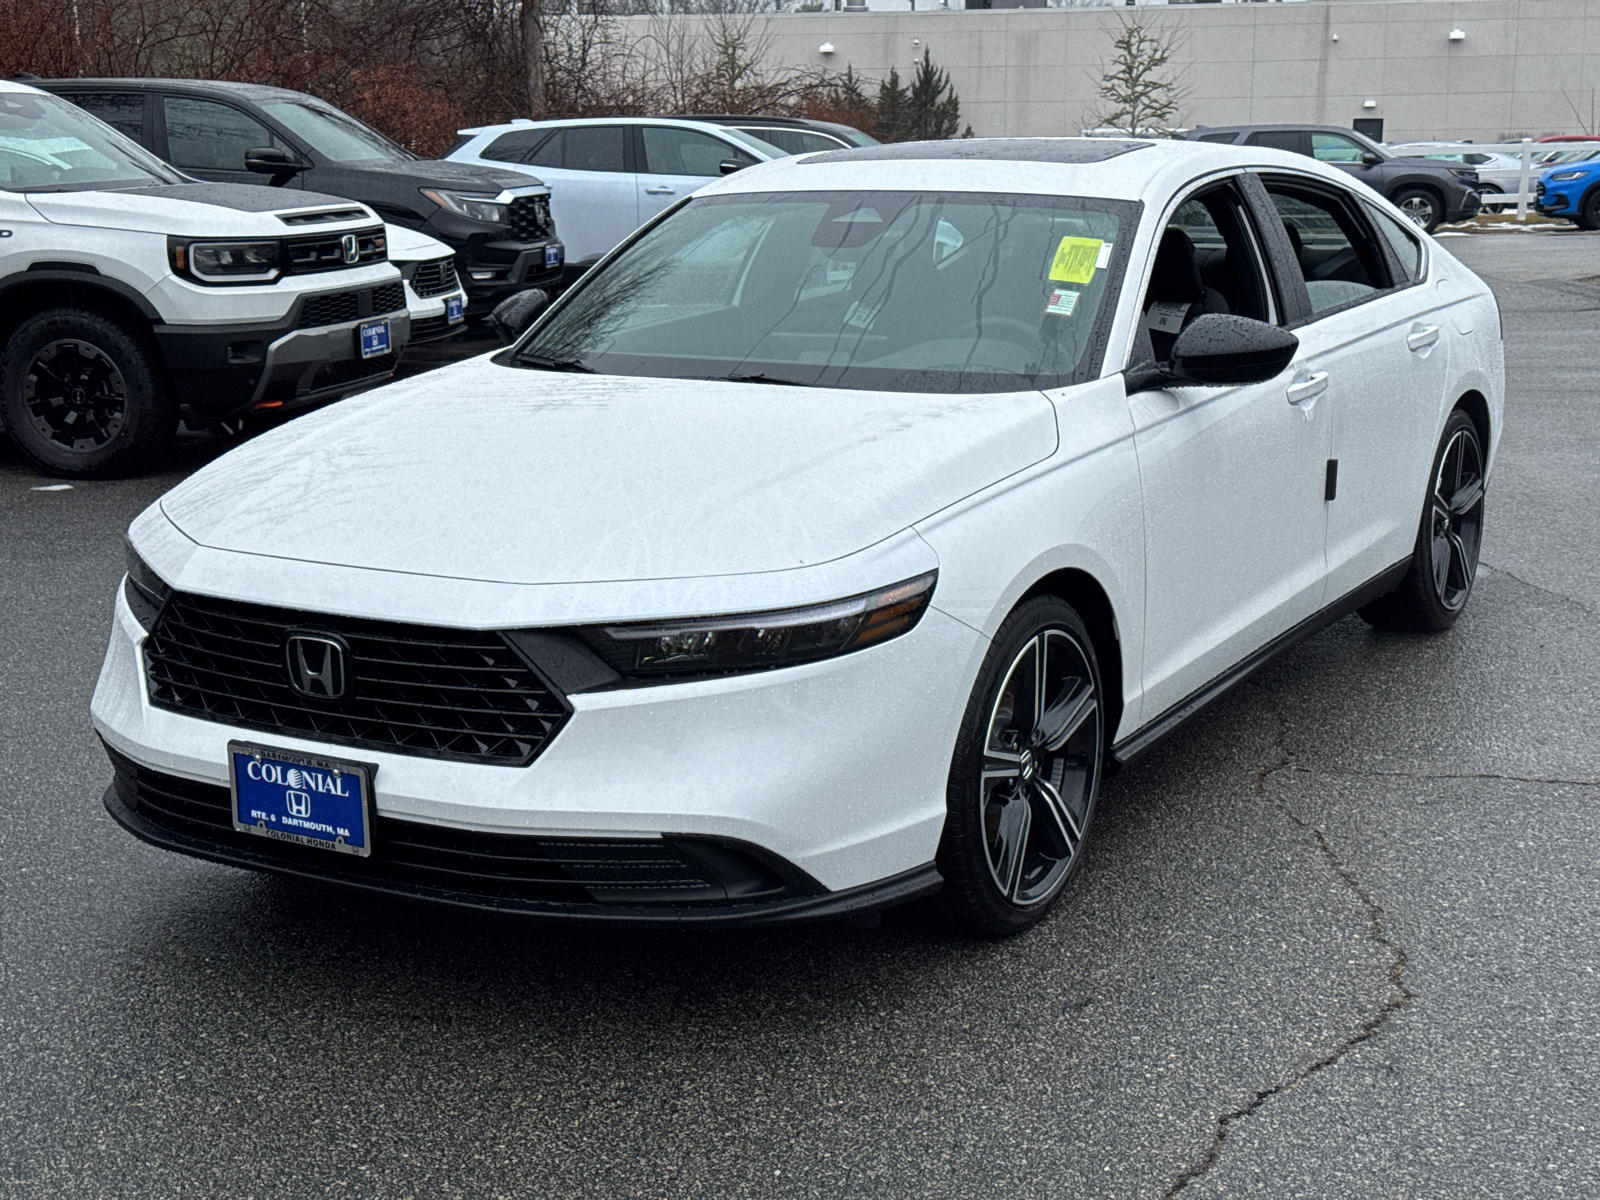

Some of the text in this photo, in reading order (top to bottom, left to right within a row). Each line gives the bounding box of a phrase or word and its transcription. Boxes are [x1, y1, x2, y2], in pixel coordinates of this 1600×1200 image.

[247, 761, 349, 797] COLONIAL
[251, 809, 350, 837] RTE. 6 DARTMOUTH, MA
[265, 829, 336, 850] COLONIAL HONDA
